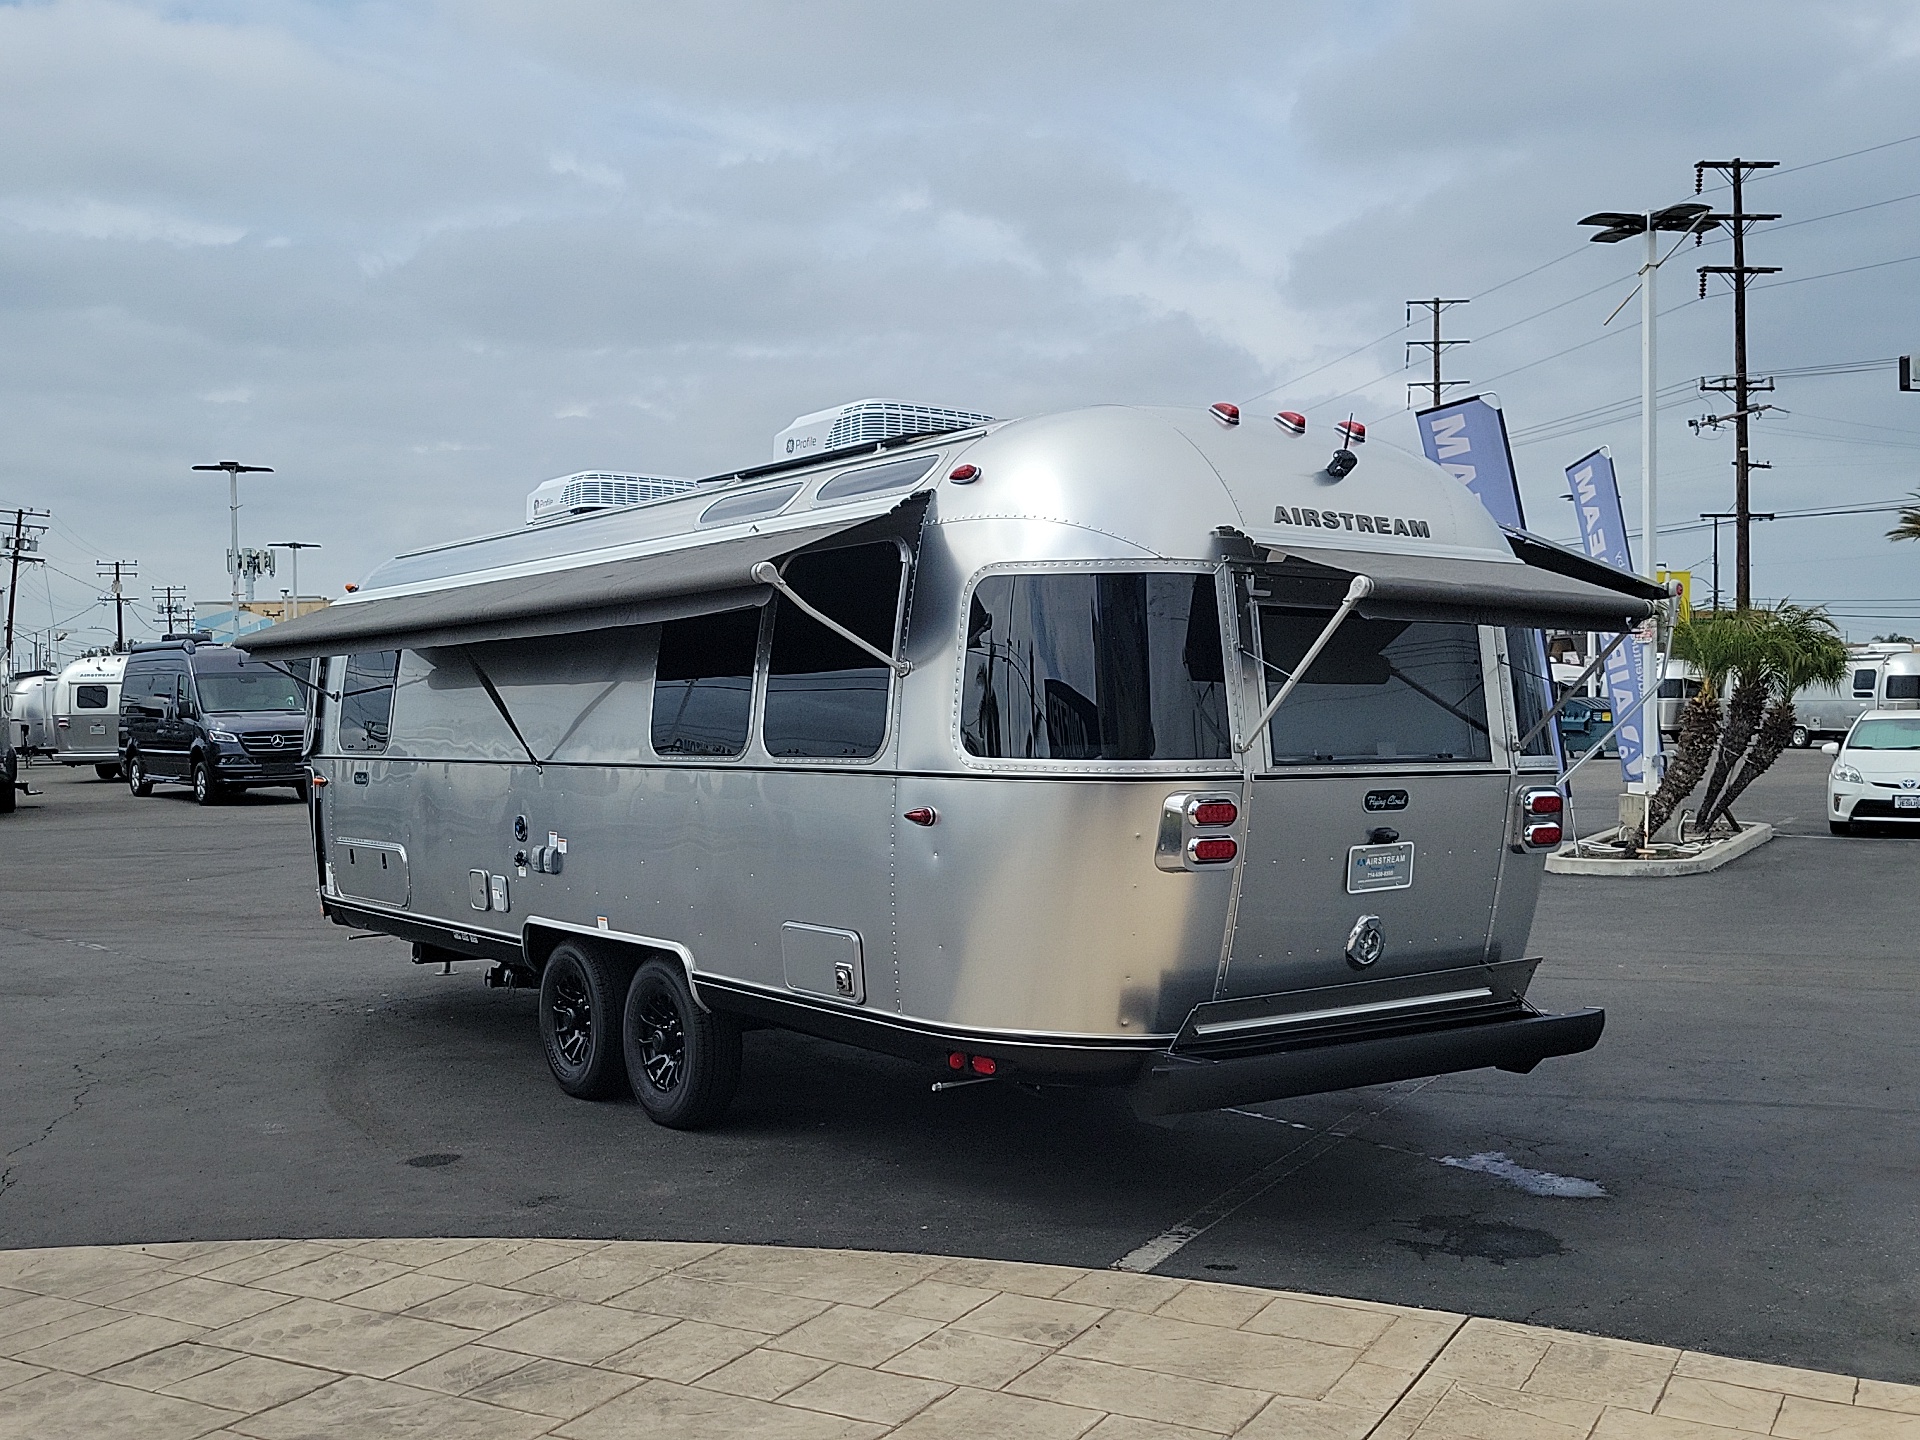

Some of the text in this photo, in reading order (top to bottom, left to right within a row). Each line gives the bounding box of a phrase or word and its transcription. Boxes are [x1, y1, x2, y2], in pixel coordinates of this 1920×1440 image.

[795, 437, 816, 450] Profile
[1274, 506, 1430, 538] AIRSTREAM
[1366, 855, 1405, 865] AIRSTREAM
